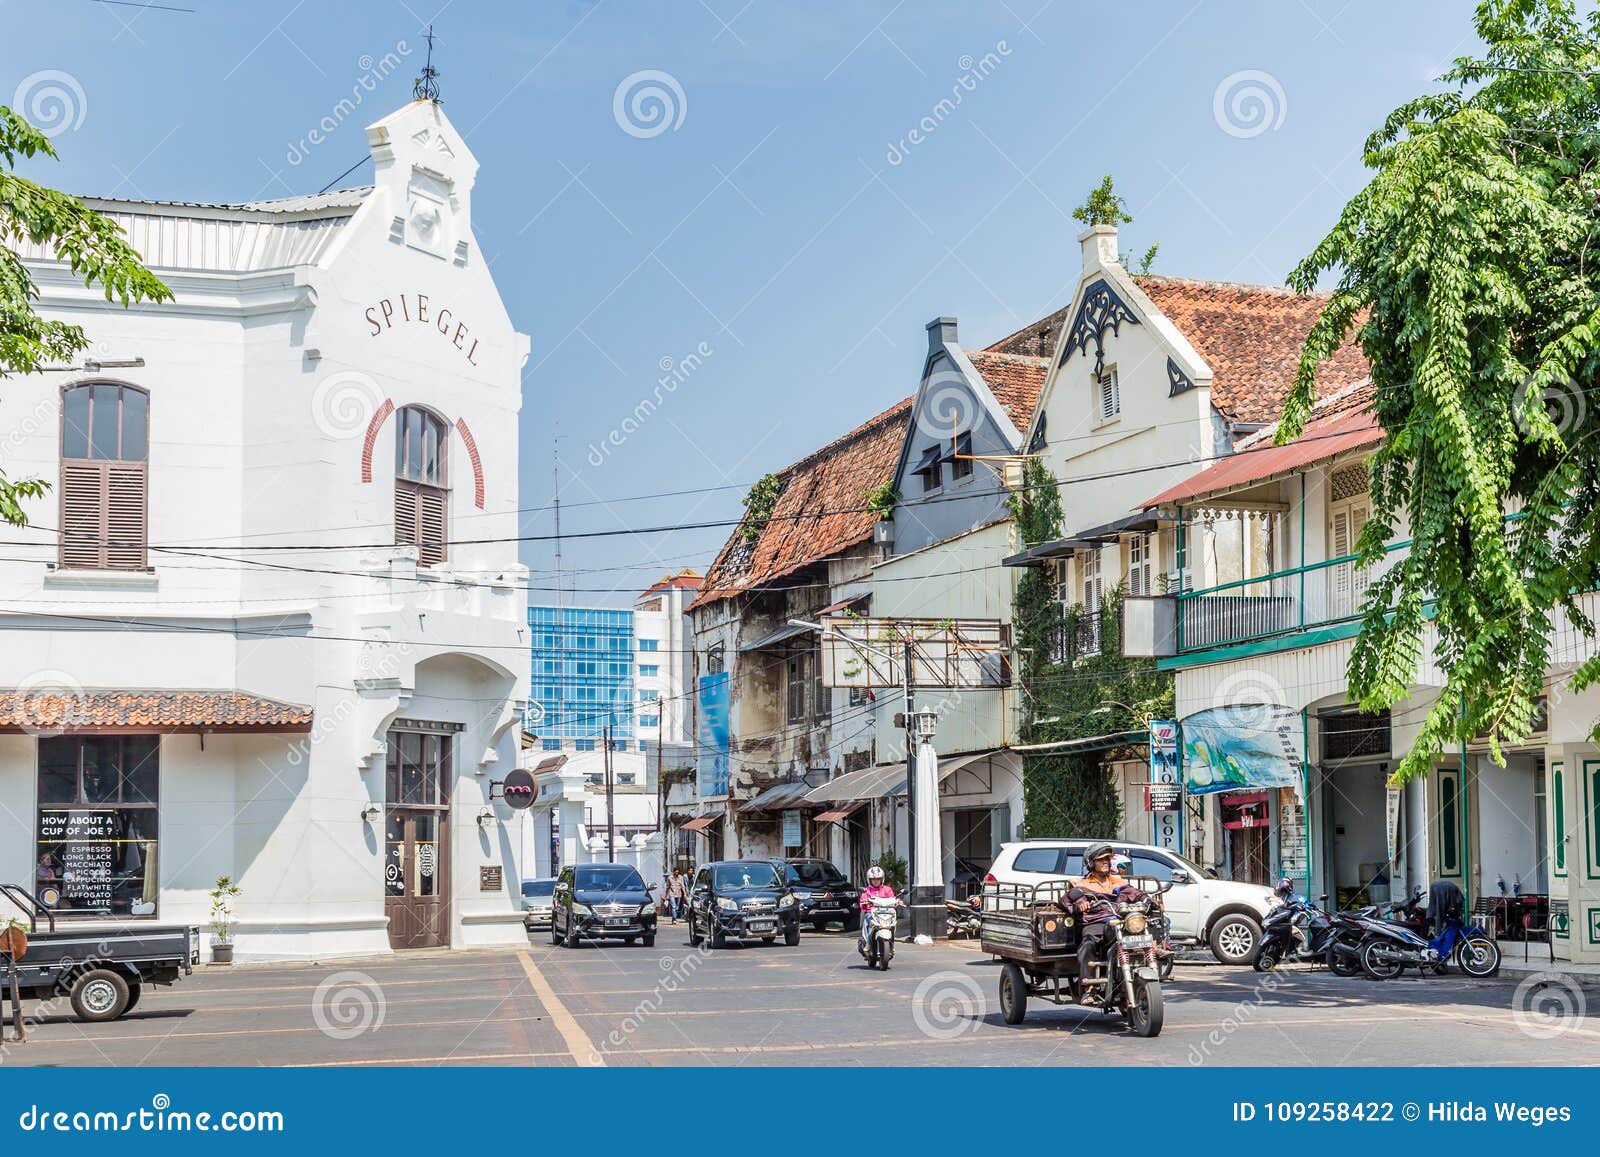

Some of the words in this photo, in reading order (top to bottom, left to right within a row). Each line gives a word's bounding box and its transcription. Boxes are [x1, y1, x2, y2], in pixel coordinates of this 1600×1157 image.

[365, 294, 479, 366] SPIEGEL
[42, 817, 67, 825] HOW
[70, 817, 103, 825] ABOUT
[106, 817, 113, 825] A
[42, 827, 63, 835] CUP
[66, 827, 80, 835] OF
[84, 827, 104, 835] JOE
[1163, 815, 1174, 847] COP
